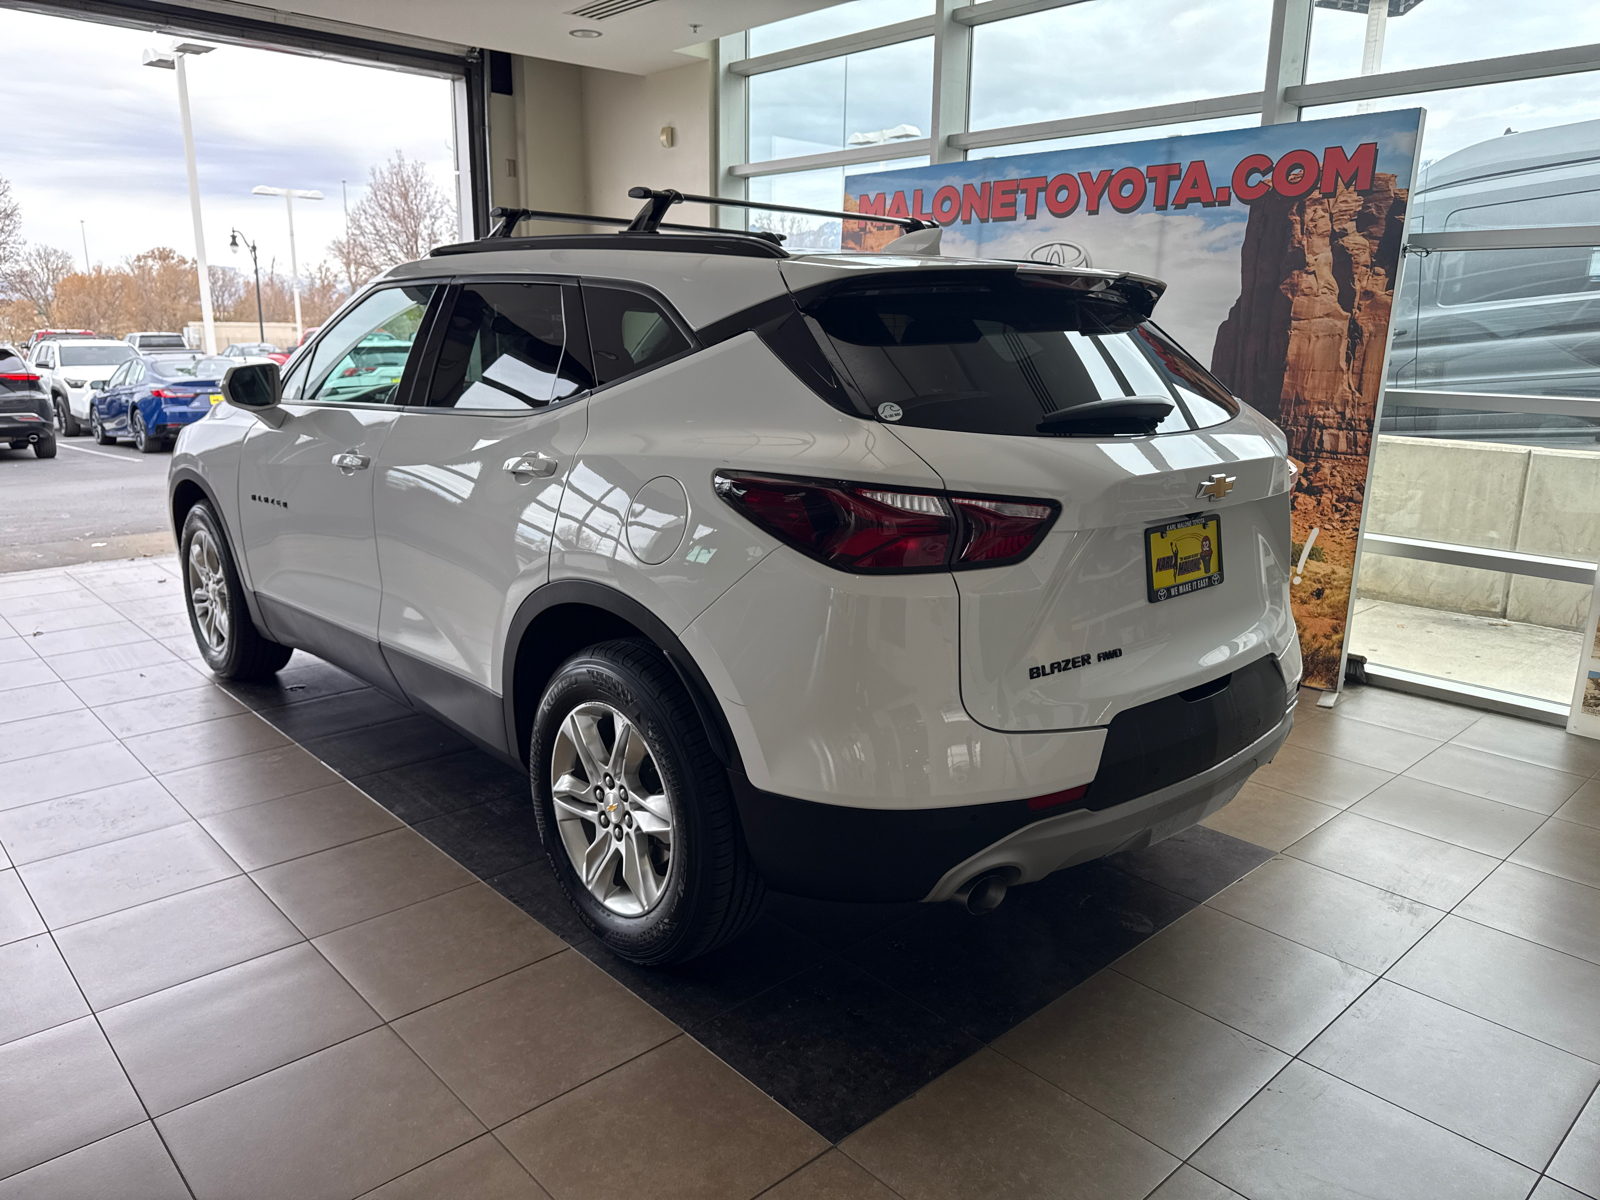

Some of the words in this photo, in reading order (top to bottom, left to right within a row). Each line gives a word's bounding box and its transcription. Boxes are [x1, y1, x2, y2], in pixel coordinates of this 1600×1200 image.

[858, 142, 1379, 231] MALONETOYOTA.COM
[1202, 541, 1210, 551] 32
[1170, 588, 1178, 596] WE
[1178, 584, 1192, 594] MAKE
[1192, 582, 1197, 591] IT
[1198, 578, 1209, 588] EASY
[1029, 653, 1092, 680] BLAZER
[1097, 647, 1123, 663] AWD
